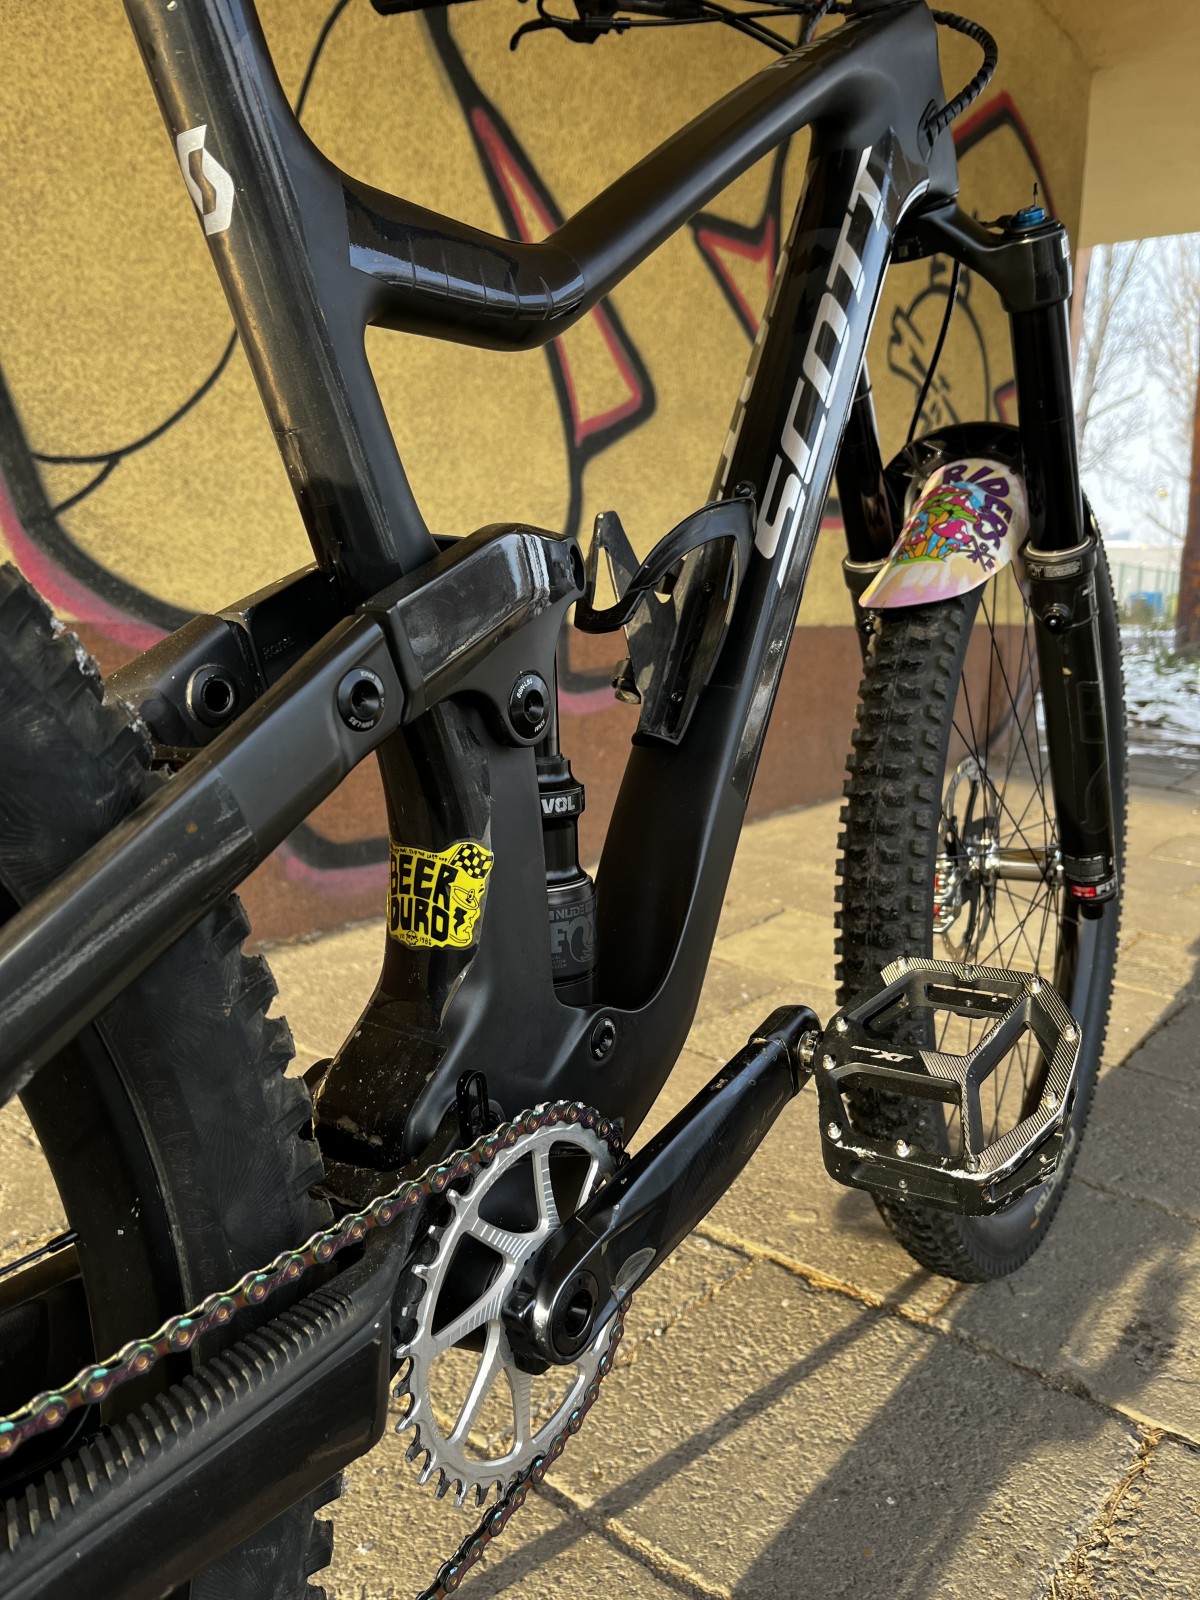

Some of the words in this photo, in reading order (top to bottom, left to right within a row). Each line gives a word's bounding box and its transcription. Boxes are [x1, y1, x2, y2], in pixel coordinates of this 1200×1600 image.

[755, 145, 884, 589] SCOTT
[541, 796, 576, 814] VOL
[390, 852, 459, 911] BEER
[390, 896, 450, 943] DURO
